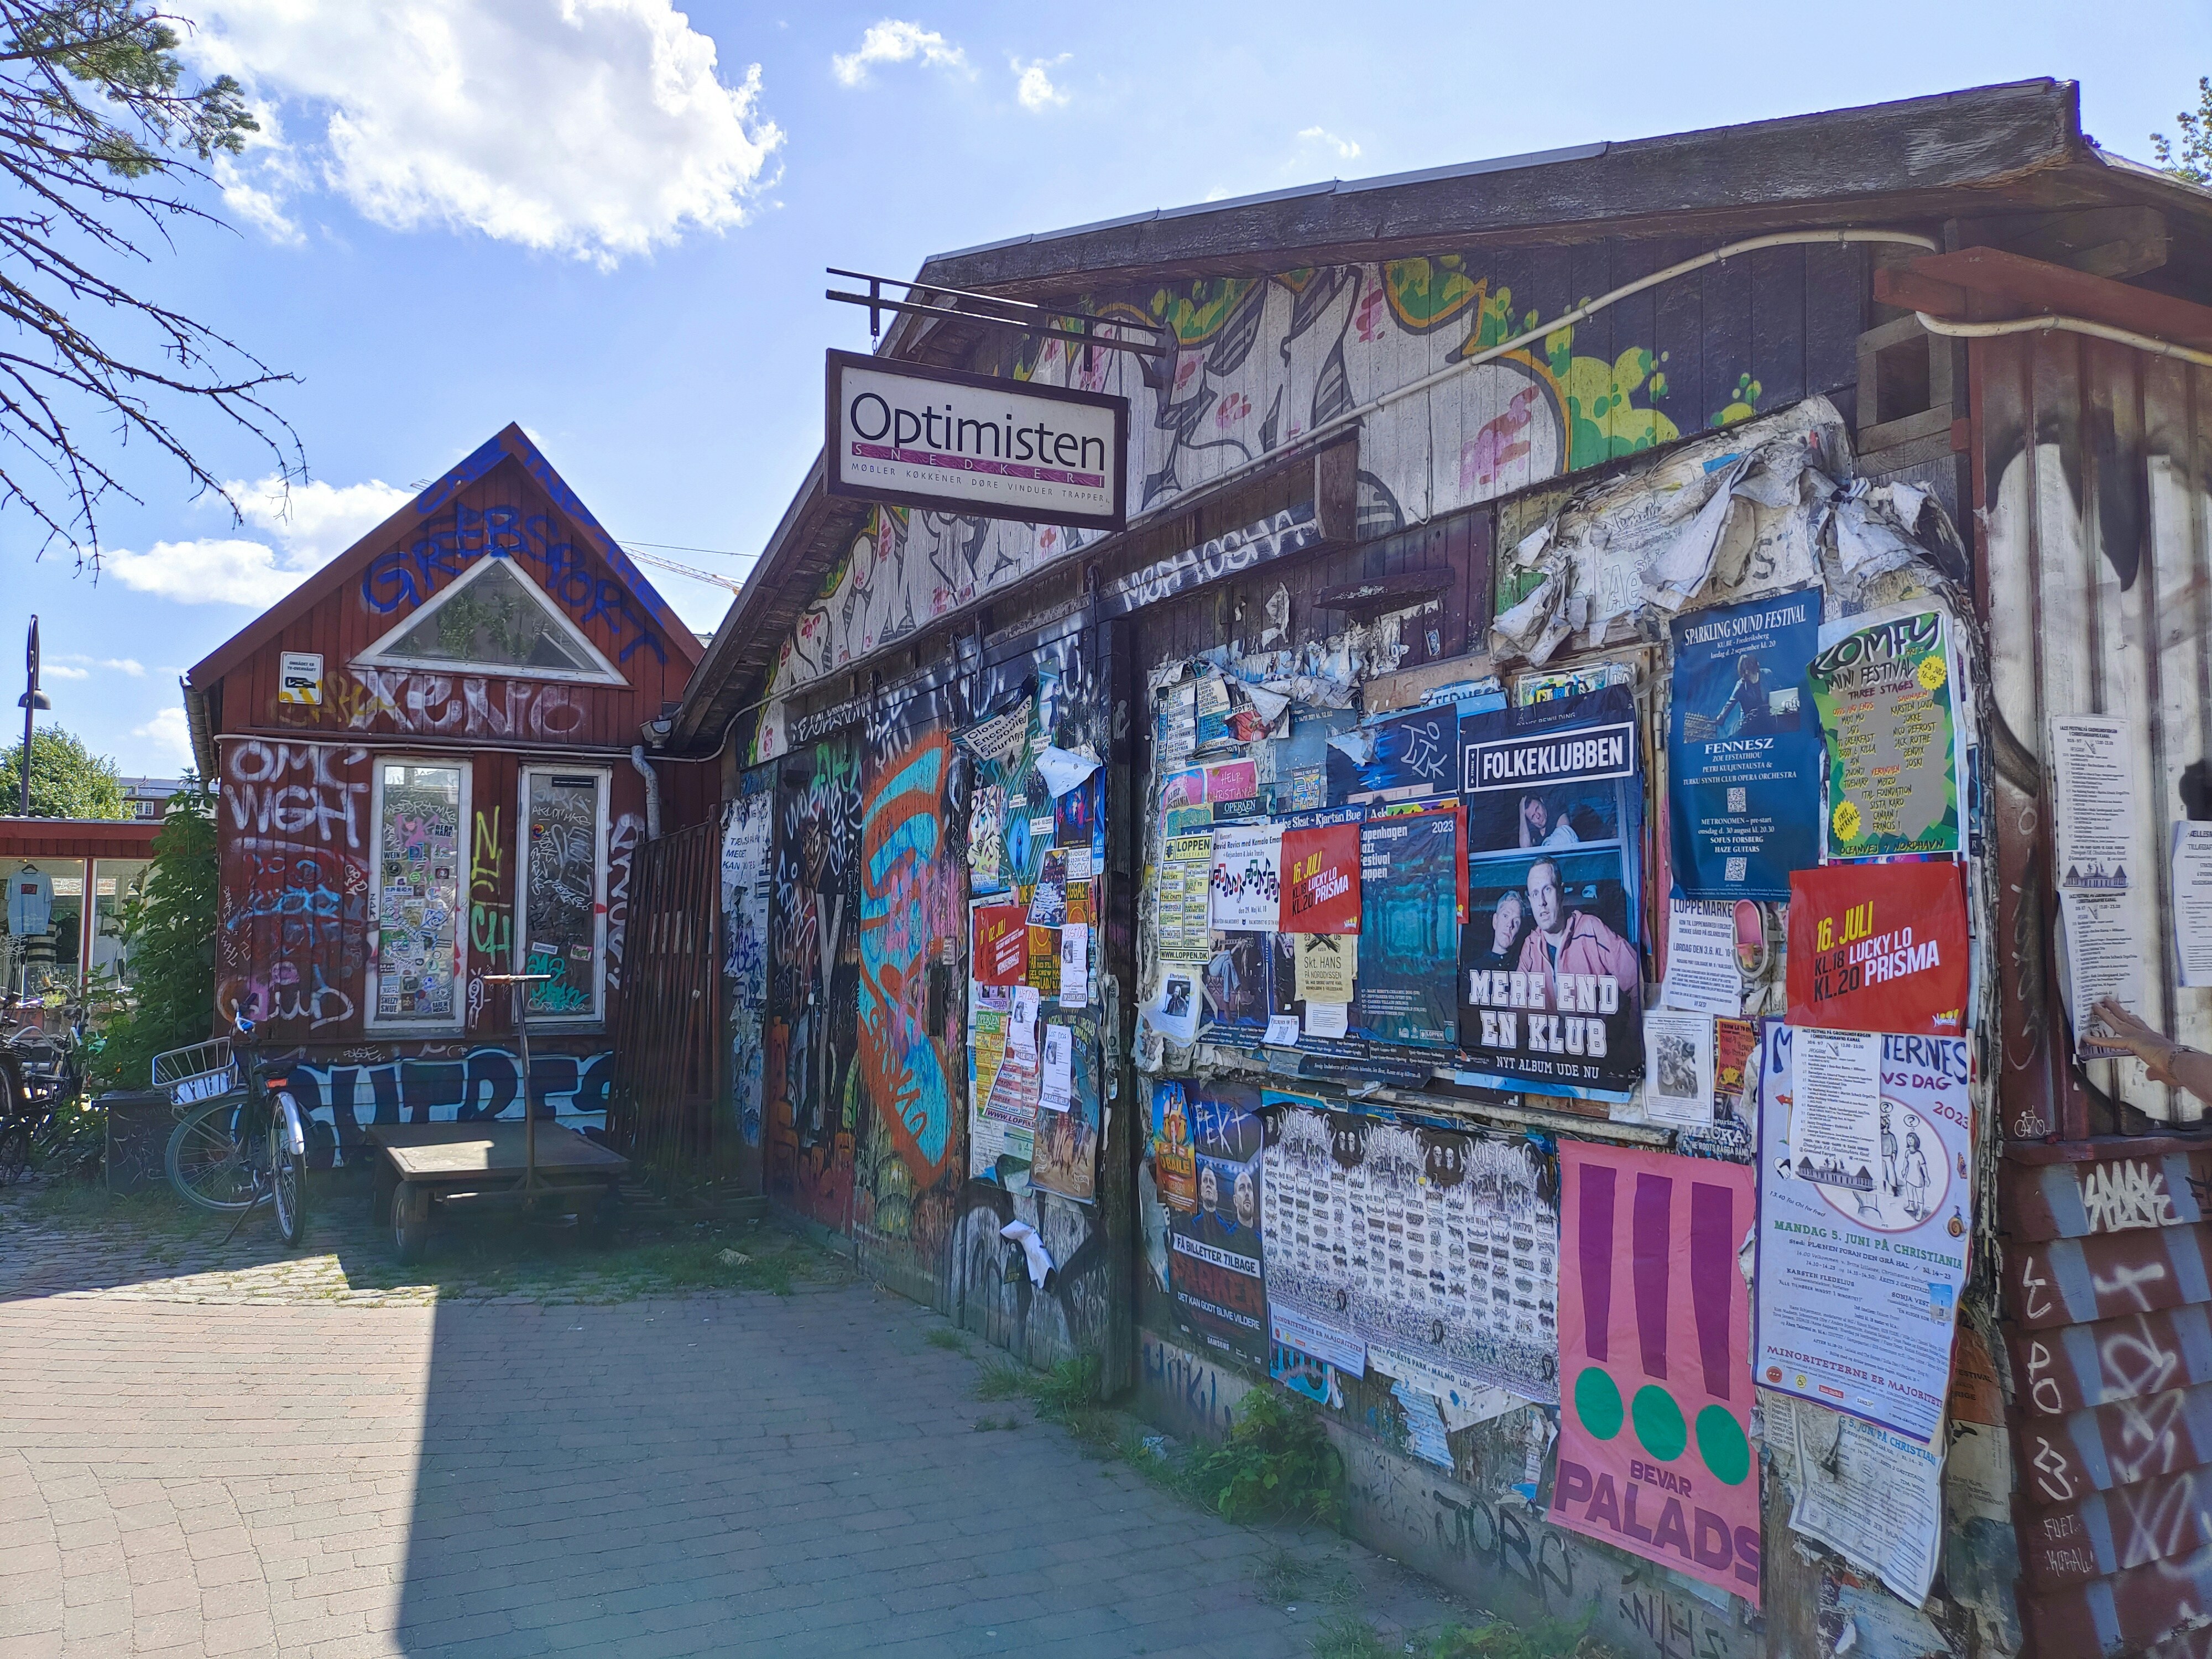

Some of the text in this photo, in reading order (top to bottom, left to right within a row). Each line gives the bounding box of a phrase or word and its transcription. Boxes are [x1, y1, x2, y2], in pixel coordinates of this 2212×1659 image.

[851, 392, 1105, 471] Optimisten
[855, 444, 1103, 487] SNEDKERI
[852, 462, 1104, 502] MØBLER KØKKENER DØRE VINDUER TRAPPER
[1684, 604, 1806, 646] SPARKLING SOUND FESTIVAL
[1735, 644, 1760, 655] september
[1736, 633, 1769, 645] Frederiksberg
[1809, 613, 1943, 680] KOMFY
[1825, 658, 1916, 694] MINI FESTIVAL
[1848, 680, 1914, 701] THREE STAGES
[1891, 703, 1914, 717] KARSTEN
[968, 719, 1001, 739] Close
[973, 700, 1030, 747] Encounters
[980, 713, 1027, 753] Embodied
[985, 731, 1024, 758] Journeys
[1704, 738, 1774, 754] FENNESZ
[1725, 752, 1762, 761] EFSTATHIOU
[1483, 735, 1623, 780] FOLKEKLUBBEN
[1719, 762, 1765, 772] KULJUNTAUSTA
[1221, 772, 1243, 785] HELP
[1759, 771, 1797, 780] ORCHESTRA
[1877, 784, 1912, 799] FOUNDATION
[1292, 810, 1361, 828] Skat Kjartan Bue
[1432, 820, 1454, 834] 2023
[1750, 817, 1772, 825] pre-start
[1837, 808, 1859, 836] ENTRANCE
[1838, 807, 1849, 824] FREE
[1177, 839, 1211, 852] LOPPEN
[1213, 841, 1226, 850] David
[1252, 837, 1268, 846] Kamala
[1893, 838, 1944, 852] NORDHAVN
[1293, 851, 1322, 885] 16. JULI
[1308, 870, 1328, 892] LUCKY
[1328, 866, 1337, 880] LO
[1292, 874, 1349, 916] KL.20 PRISMA
[1816, 900, 1874, 952] 16. JULI
[1161, 951, 1208, 960] WWW.LOPPEN.DK
[1673, 942, 1692, 951] LØRDAG
[1693, 945, 1703, 953] DEN
[1715, 947, 1724, 956] KL.
[1814, 926, 1912, 977] KL.18 LUCKY LO
[1320, 957, 1341, 968] HANS
[1814, 940, 1940, 1003] KL.20 PRISMA
[1557, 973, 1619, 1015] END
[1479, 1010, 1608, 1058] EN KLUB
[1496, 1056, 1599, 1079] NYT ALBUM UDE NU
[1177, 1237, 1256, 1274] FÅ BILLETTER TILBAGE
[1774, 1220, 1962, 1270] MANDAG 5. JUNI PÅ CHRISTIANIA
[1807, 1240, 1838, 1253] PLÆNEN
[1839, 1248, 1861, 1258] FORAN
[1879, 1255, 1895, 1265] GRÅ
[1896, 1261, 1910, 1269] HAL
[1787, 1268, 1818, 1279] KARSTEN
[1891, 1292, 1913, 1302] SONJA
[1177, 1291, 1260, 1331] DET KAN GODT BLIVE VILDERE
[1207, 1336, 1229, 1350] SAMSUNG
[1386, 1350, 1427, 1371] FOLKETS PARK
[1767, 1345, 1884, 1385] MINORITETERNE ER
[1631, 1459, 1692, 1498] BEVAR
[1554, 1459, 1760, 1587] PALADS
